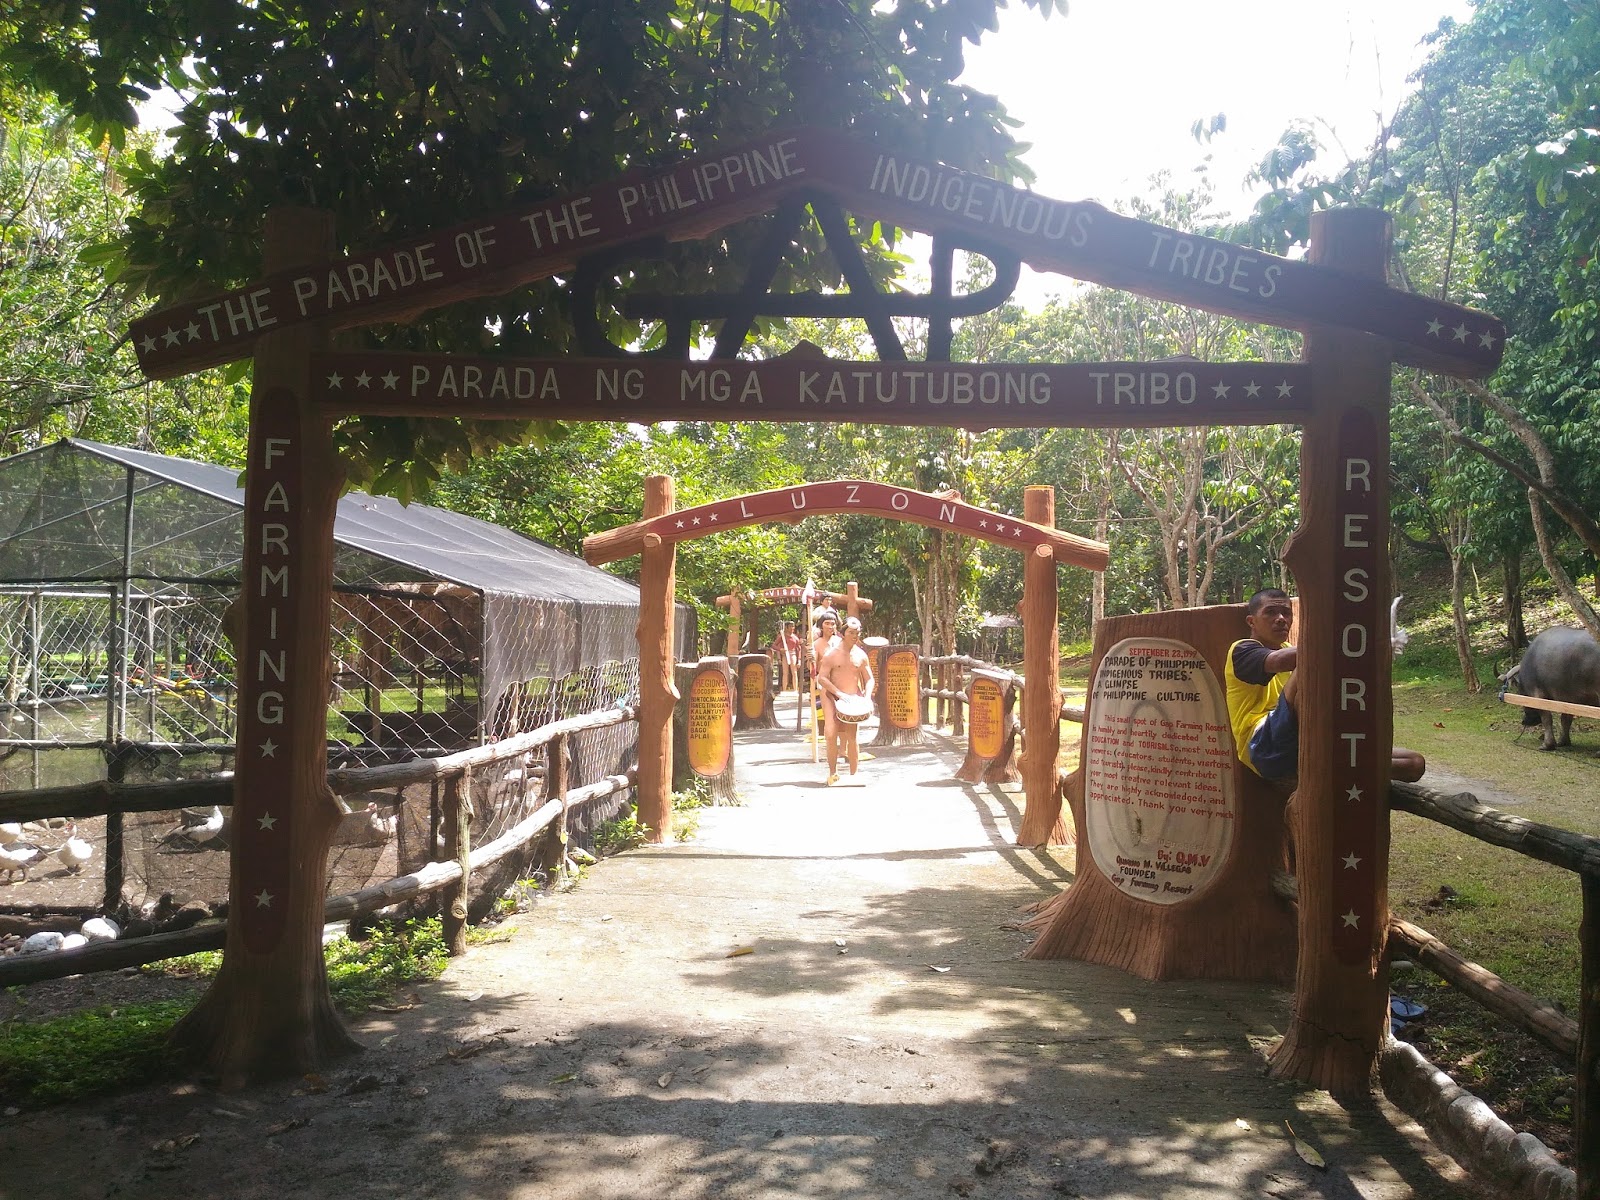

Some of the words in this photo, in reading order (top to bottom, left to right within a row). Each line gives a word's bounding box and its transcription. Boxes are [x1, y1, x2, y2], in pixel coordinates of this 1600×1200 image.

[868, 154, 1094, 249] INDIGENOUS
[1147, 229, 1283, 299] TRIBES
[198, 288, 279, 343] THE
[293, 242, 444, 318] PARADE
[455, 226, 498, 270] OF
[520, 197, 601, 251] THE
[618, 137, 806, 226] PHILIPPINE
[409, 365, 562, 402] PARADA
[594, 367, 646, 402] NG
[680, 369, 764, 404] MGA
[797, 370, 1052, 407] KATUTUBONG
[1088, 371, 1197, 405] TRIBO
[740, 484, 957, 525] LUZON
[256, 437, 292, 726] FARMING
[1340, 457, 1372, 769] RESORT
[1104, 656, 1136, 668] PARADE
[1138, 656, 1152, 668] OF
[1129, 647, 1170, 658] SEPTEMBER
[1097, 680, 1102, 689] A
[1104, 679, 1138, 689] GLIMPSE
[1099, 669, 1143, 679] INDIGENOUS
[1148, 670, 1193, 681] TRIBES:
[1092, 691, 1099, 700] OF
[1103, 690, 1148, 700] PHILIPPINE
[1156, 691, 1202, 702] CULTURE
[1104, 714, 1116, 723] This
[1133, 718, 1147, 727] spot
[1149, 718, 1157, 726] of
[1160, 720, 1174, 730] Gap
[1176, 719, 1203, 733] Farming
[1205, 722, 1227, 732] Resort
[1098, 726, 1115, 736] humbly
[1130, 727, 1157, 740] heartily
[1161, 731, 1199, 742] dedicated
[1206, 735, 1217, 743] to
[1091, 735, 1120, 745] EDUCATION
[1122, 740, 1135, 748] and
[1204, 747, 1230, 757] valued
[1120, 774, 1151, 784] creative
[1090, 779, 1104, 790] They
[1121, 784, 1142, 797] highly
[1209, 796, 1226, 806] and
[1138, 798, 1165, 810] Thank
[1169, 805, 1187, 815] you
[1190, 808, 1214, 819] very
[1215, 810, 1234, 819] much
[1119, 866, 1156, 880] FOUNDER
[1162, 881, 1195, 895] Resort
